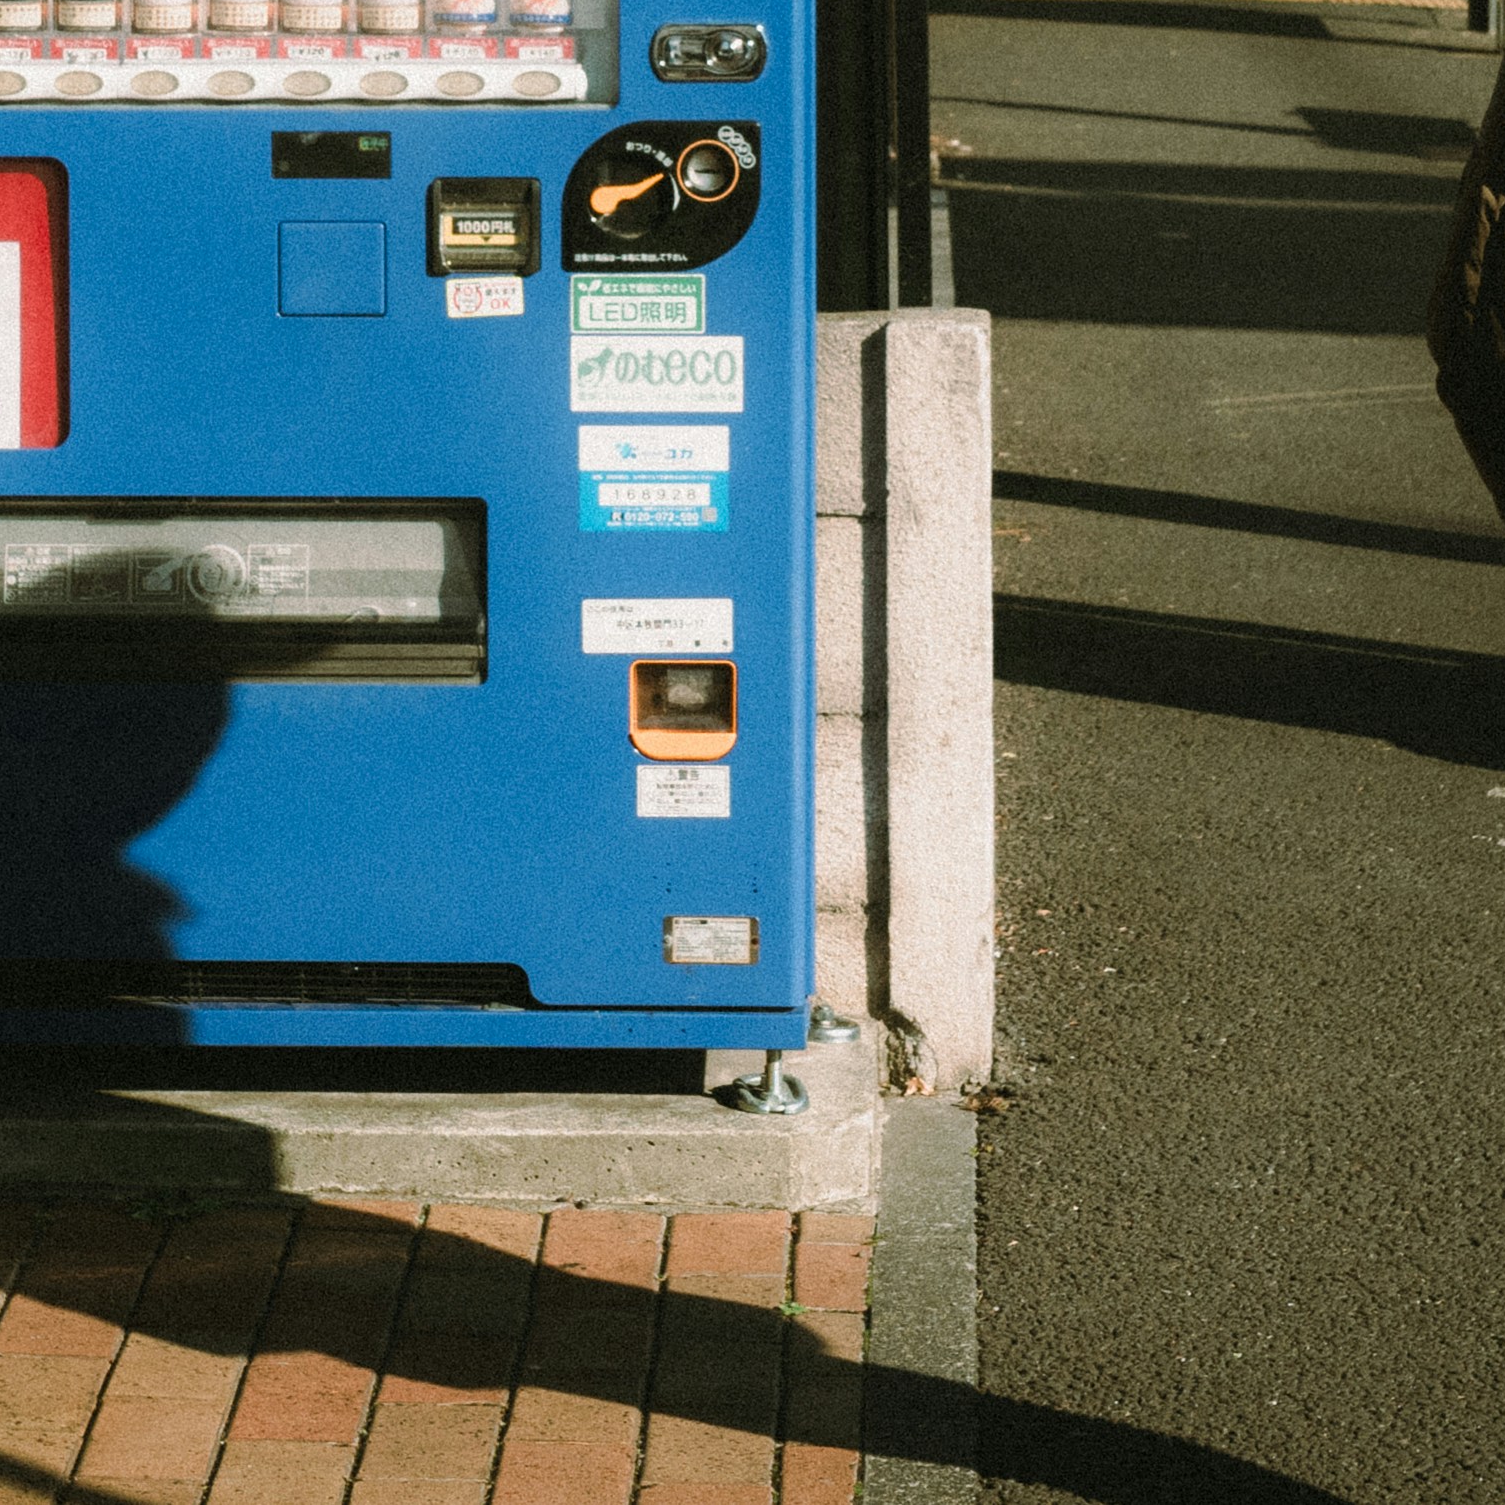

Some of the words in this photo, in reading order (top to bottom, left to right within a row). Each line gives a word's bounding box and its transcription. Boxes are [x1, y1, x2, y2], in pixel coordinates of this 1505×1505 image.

[456, 220, 515, 234] 1000円札
[490, 298, 510, 310] OK
[589, 301, 687, 324] LED照明
[615, 349, 737, 386] のむeco
